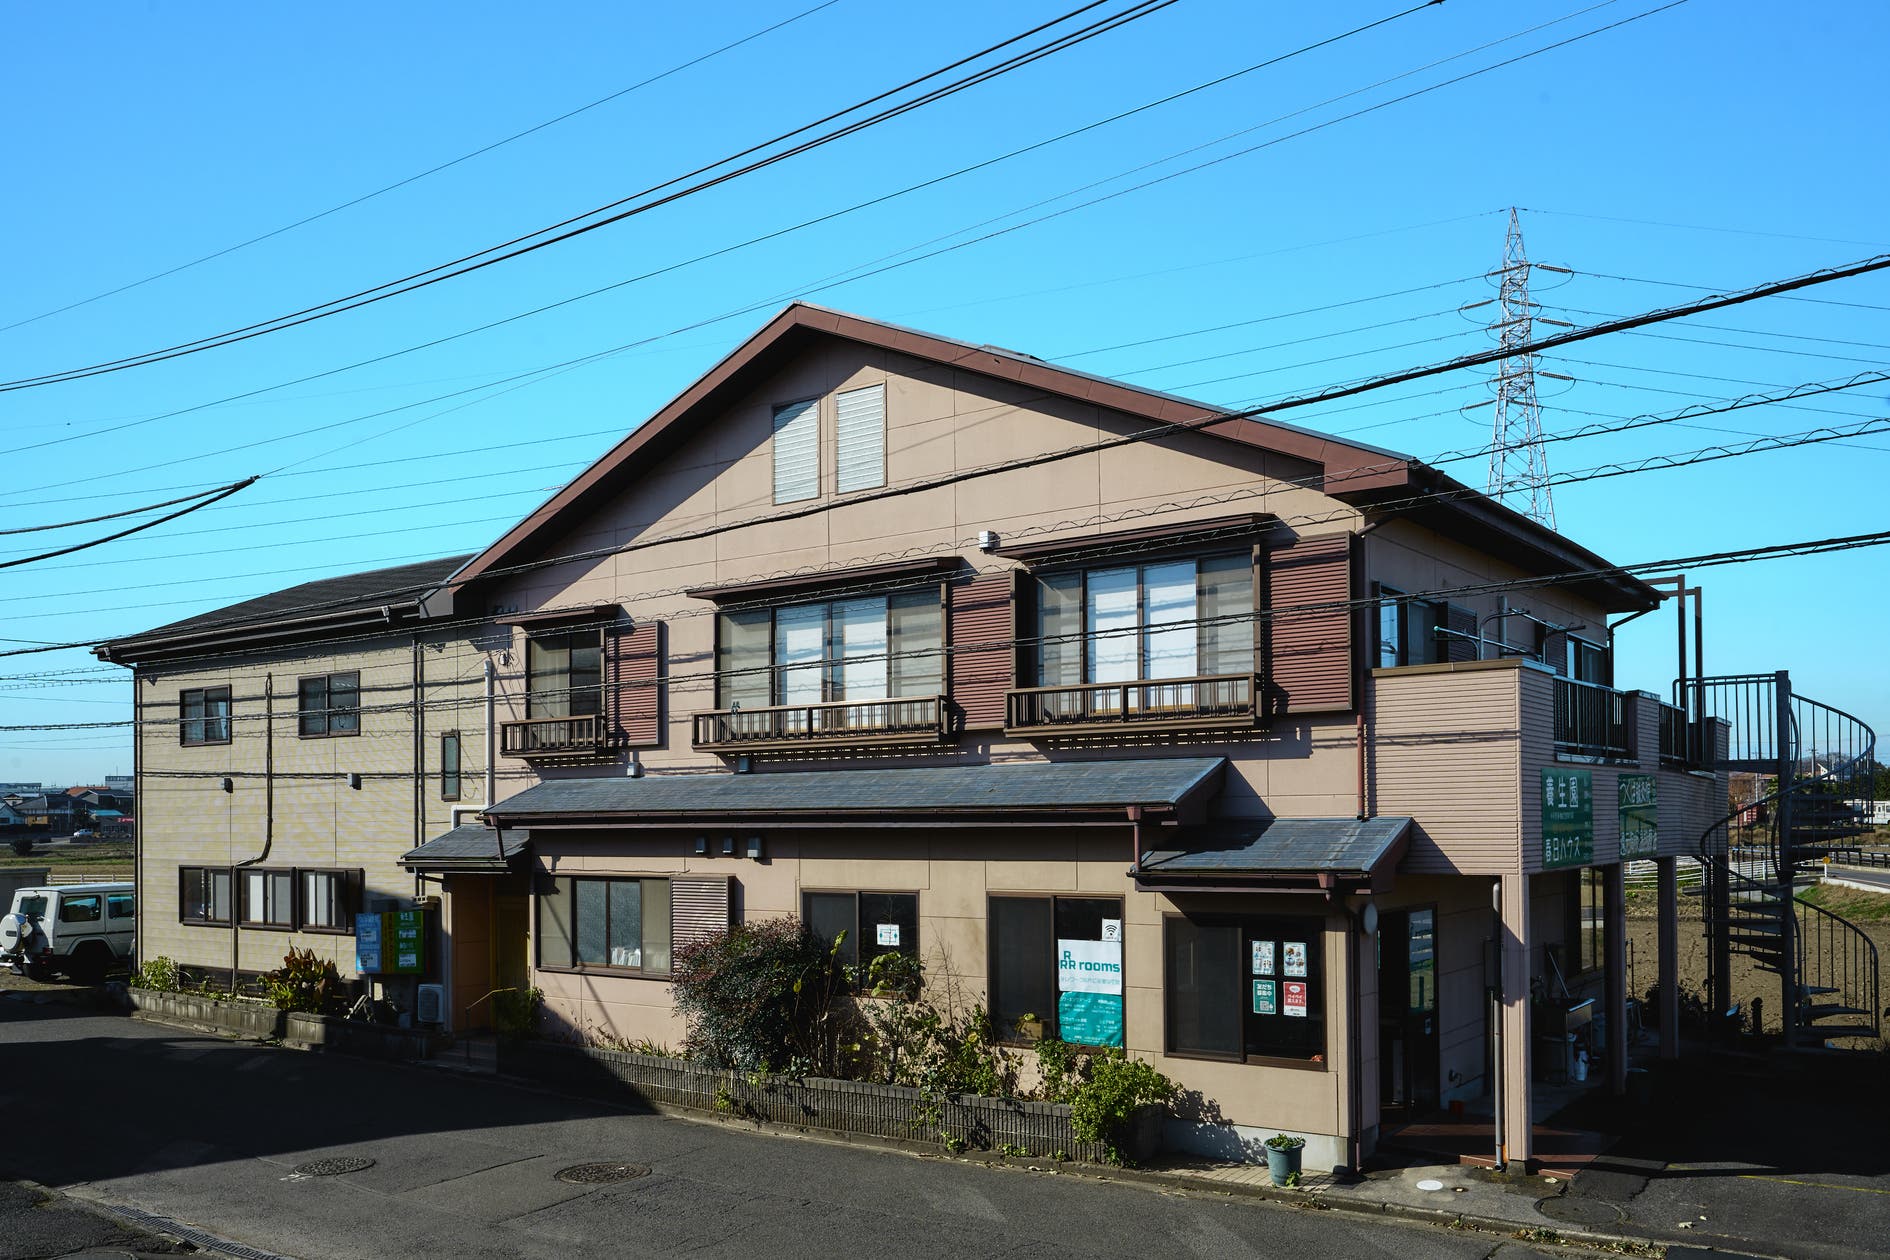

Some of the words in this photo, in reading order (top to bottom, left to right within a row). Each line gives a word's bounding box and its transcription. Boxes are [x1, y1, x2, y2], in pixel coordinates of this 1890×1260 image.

[1545, 837, 1580, 862] 春日ハウス
[1060, 959, 1076, 970] RR
[1079, 961, 1120, 973] rooms
